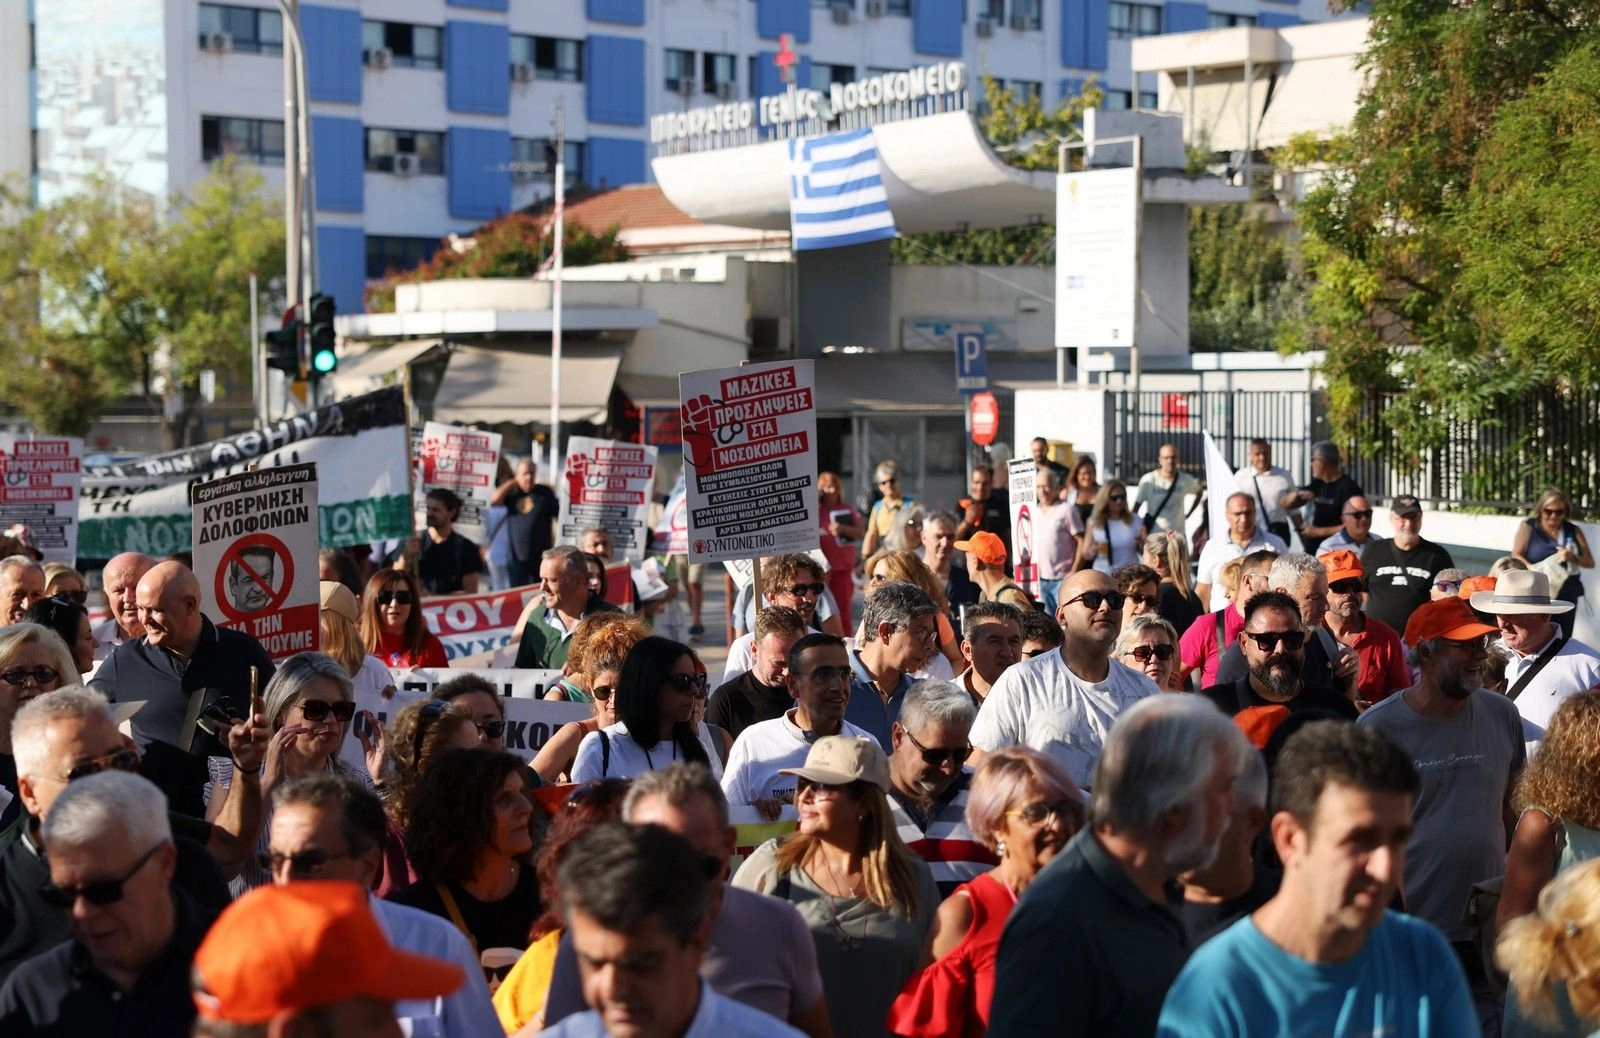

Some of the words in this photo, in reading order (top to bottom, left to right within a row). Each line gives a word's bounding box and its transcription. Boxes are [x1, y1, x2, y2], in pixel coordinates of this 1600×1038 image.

[831, 62, 966, 114] ΝΟΣΟΚΟΜΕΙΟ
[963, 335, 980, 374] P
[726, 371, 792, 398] ΜΑΖΙΚΕΣ
[715, 392, 808, 425] ΠΡΟΣΛΗΨΕΙΣ
[751, 421, 774, 438] ΣΤΑ
[720, 437, 802, 466] ΝΟΣΟΚΟΜΕΙΑ
[700, 467, 760, 484] ΜΟΝΙΜΟΠΟΙΗΣΗ
[762, 461, 783, 471] ΟΛΩΝ
[701, 482, 717, 492] ΤΩΝ
[719, 471, 778, 489] ΣΥΜΒΑΣΙΟΥΧΩΝ
[750, 486, 773, 497] ΣΤΟΥΣ
[775, 477, 808, 491] ΜΙΣΘΟΥΣ
[203, 487, 303, 523] ΚΥΒΕΡΝΗΣΗ
[696, 502, 756, 518] ΚΡΑΤΙΚΟΠΟΙΗΣΗ
[758, 496, 779, 507] ΟΛΩΝ
[780, 493, 796, 503] ΤΩΝ
[697, 512, 738, 526] ΙΔΙΩΤΙΚΩΝ
[740, 501, 801, 519] ΝΟΣΗΛΕΥΤΗΡΙΩΝ
[199, 506, 309, 545] ΔΟΛΟΦΟΝΩΝ
[720, 524, 740, 536] ΑΡΣΗ
[741, 521, 758, 532] ΤΩΝ
[760, 511, 805, 528] ΑΝΑΣΤΟΛΩΝ
[707, 533, 775, 553] ΣΥΝΤΟΝΙΣΤΙΚΟ
[253, 613, 282, 636] ΤΗΝ
